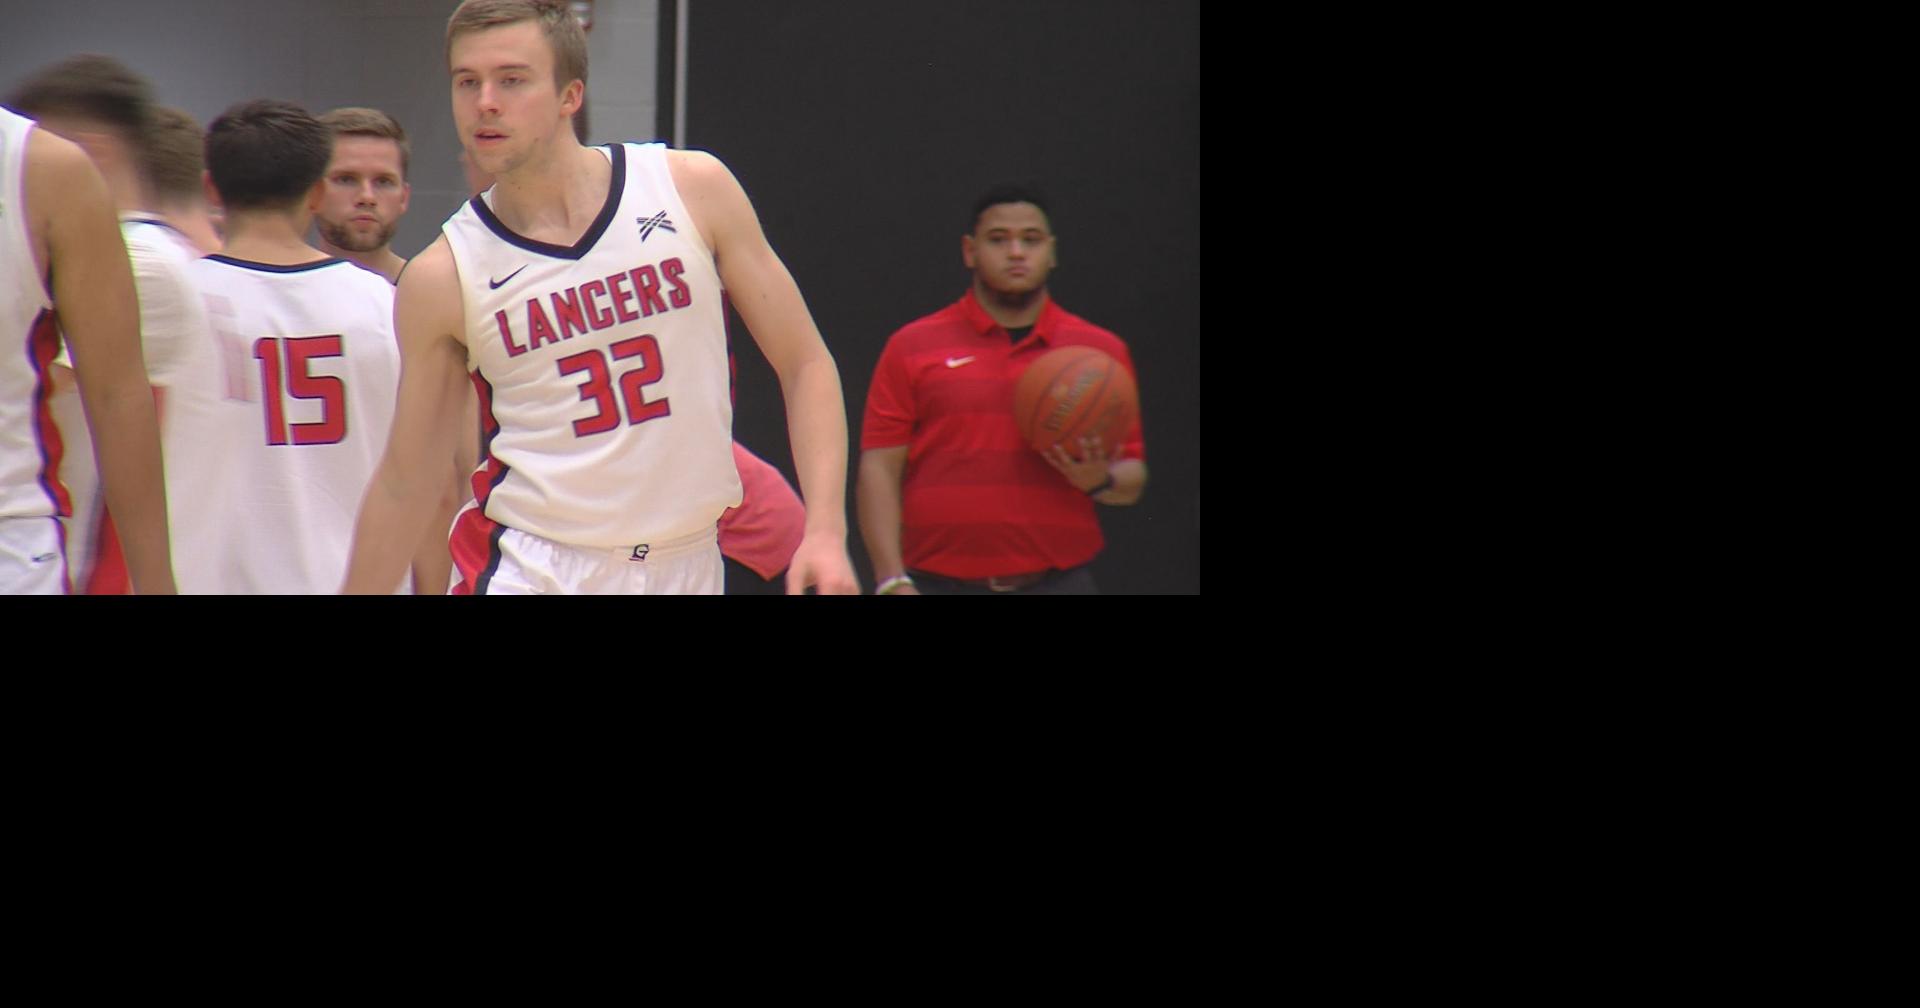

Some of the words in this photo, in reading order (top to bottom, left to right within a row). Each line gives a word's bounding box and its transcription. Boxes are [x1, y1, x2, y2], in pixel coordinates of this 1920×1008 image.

[495, 257, 692, 358] LANCERS
[253, 334, 347, 446] 15
[556, 333, 671, 438] 32
